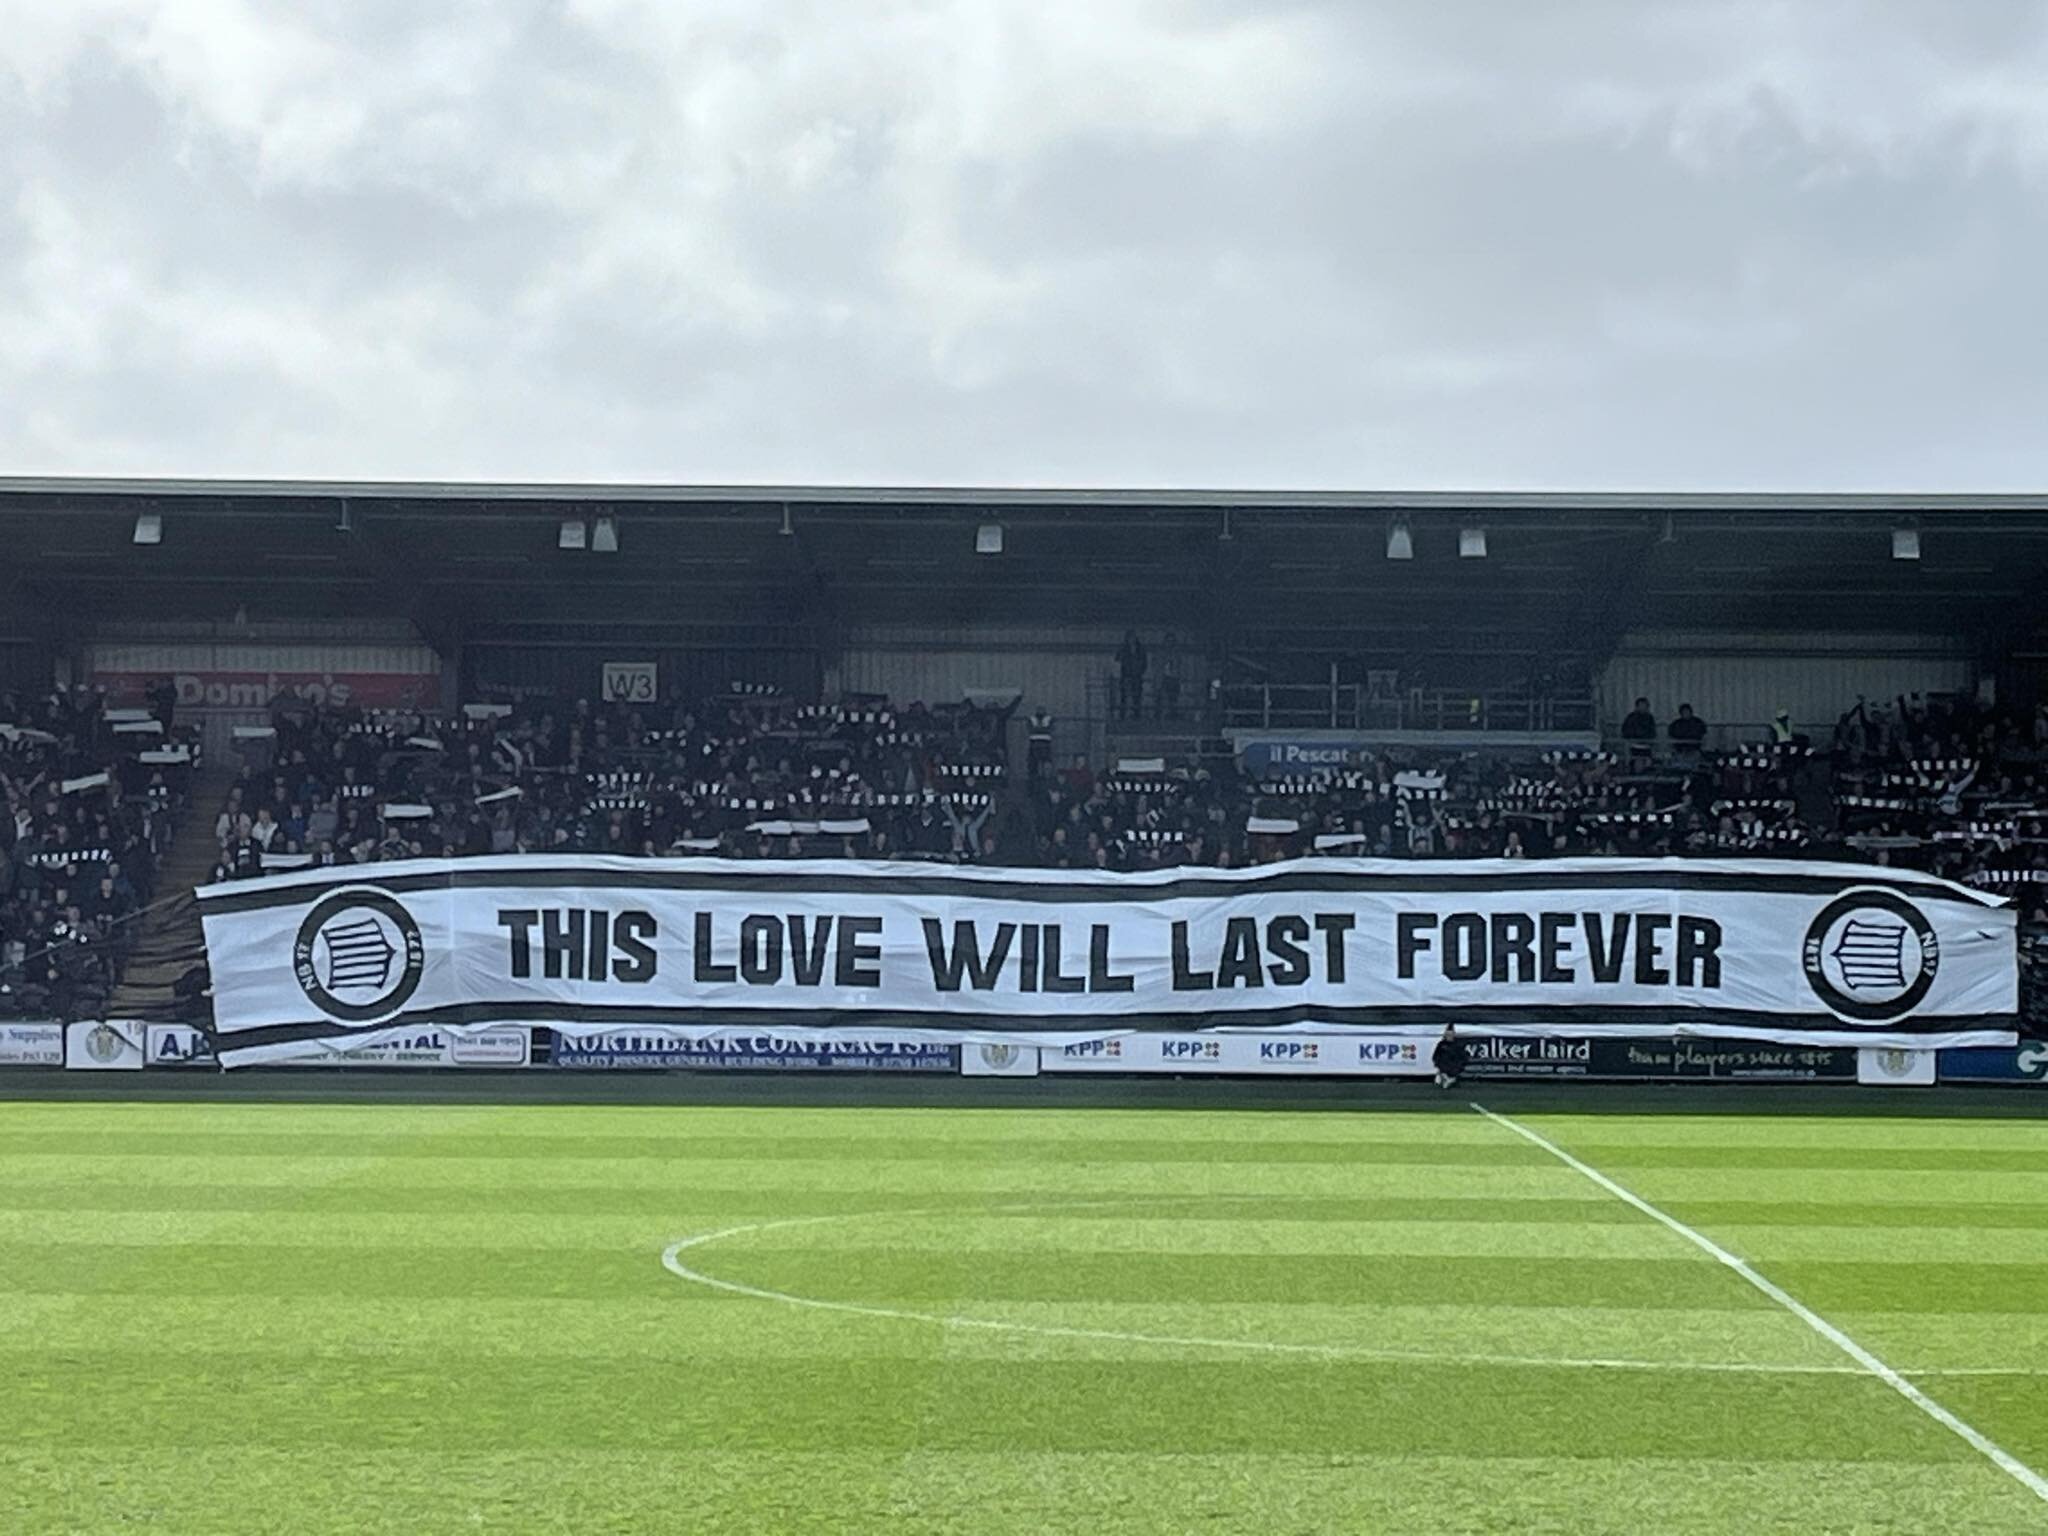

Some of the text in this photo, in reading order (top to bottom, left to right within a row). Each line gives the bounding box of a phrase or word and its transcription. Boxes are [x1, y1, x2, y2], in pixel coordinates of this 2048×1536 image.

[174, 674, 351, 707] Domio's
[607, 673, 653, 699] W3
[498, 908, 1722, 992] THIS LOVE WILL LAST FOREVER
[1064, 1040, 1104, 1057] KPP
[1161, 1041, 1203, 1058] KPP
[1260, 1042, 1302, 1059] KPP
[1359, 1043, 1400, 1060] KPP
[1540, 1038, 1591, 1060] laird
